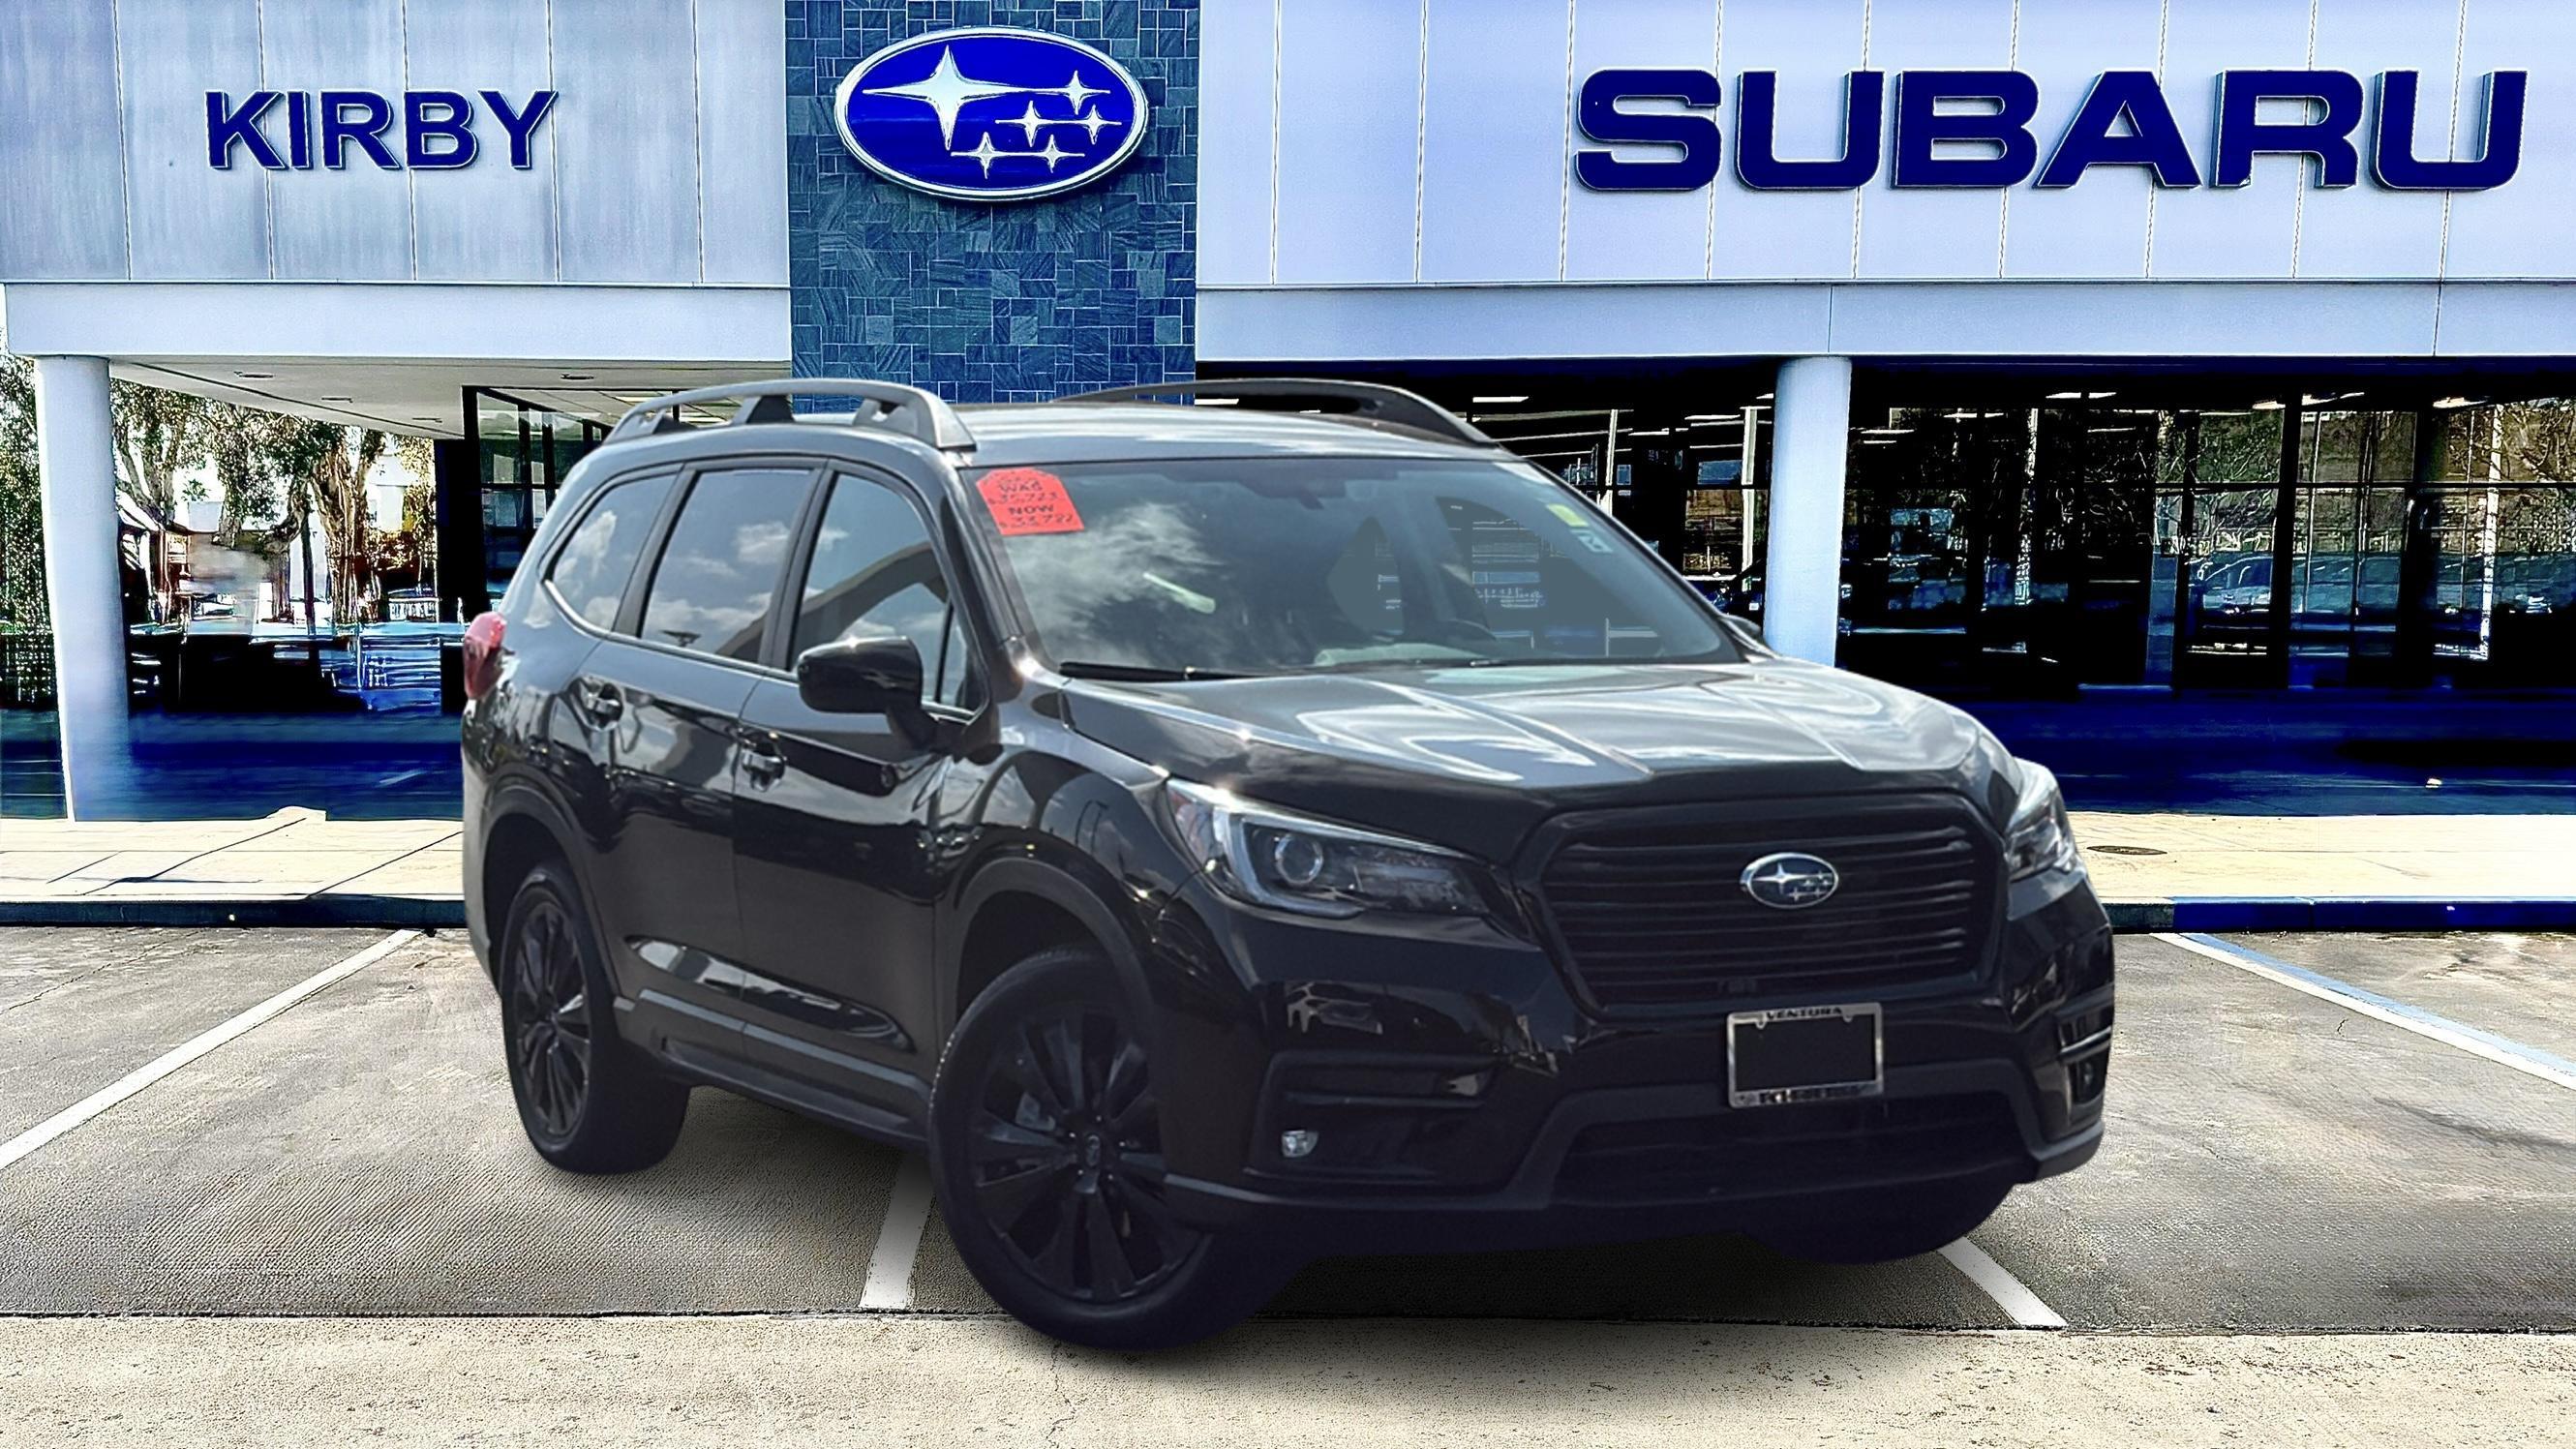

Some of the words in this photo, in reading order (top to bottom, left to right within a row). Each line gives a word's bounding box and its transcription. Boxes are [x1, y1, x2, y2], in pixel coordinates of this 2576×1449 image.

[205, 90, 559, 171] KIRBY
[1575, 69, 2528, 192] SUBARU
[1007, 503, 1054, 515] NOW
[1765, 1007, 1843, 1020] VENTURA
